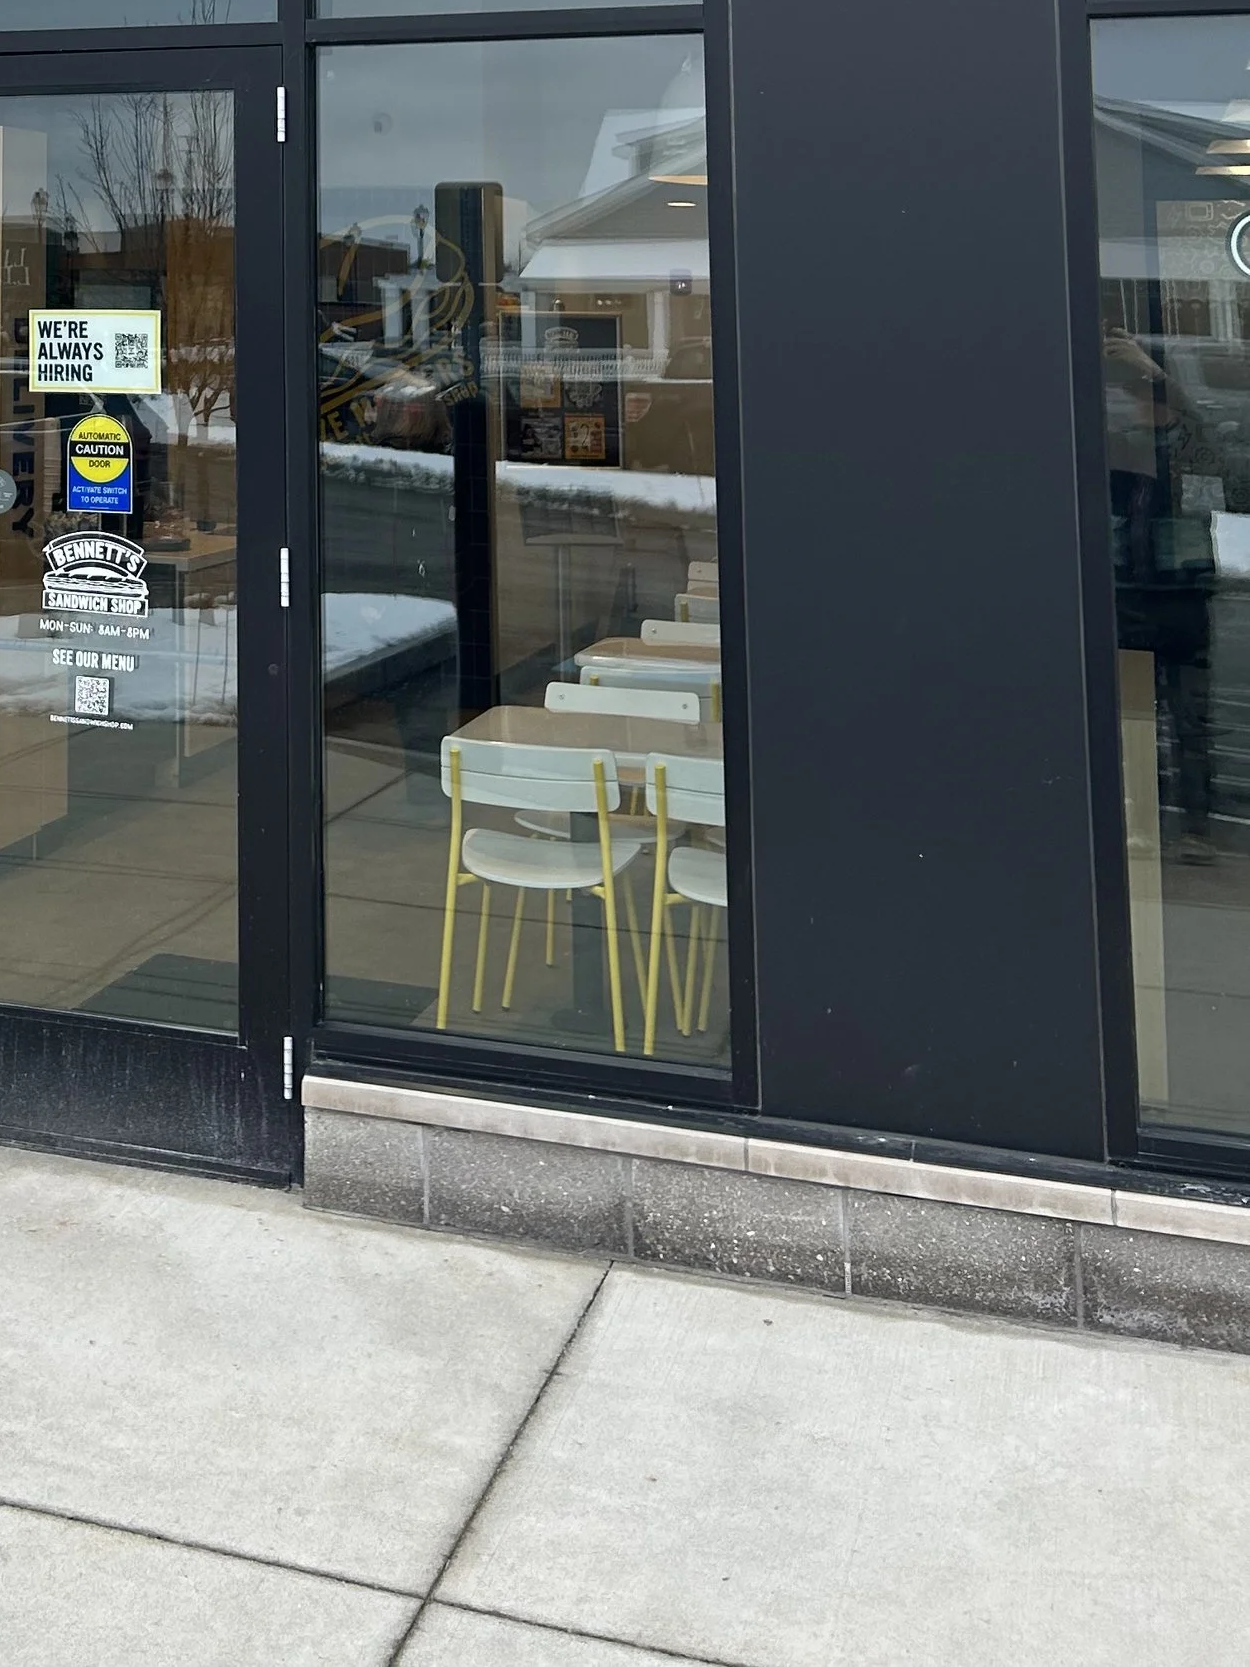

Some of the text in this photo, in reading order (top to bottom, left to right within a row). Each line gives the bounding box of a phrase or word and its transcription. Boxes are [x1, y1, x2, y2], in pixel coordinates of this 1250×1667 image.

[37, 320, 89, 339] WE'RE
[37, 342, 104, 361] ALWAYS
[37, 364, 94, 383] HIRING
[78, 431, 122, 441] AUTOMATIC
[75, 443, 125, 456] CAUTION
[89, 459, 111, 469] DOOR
[72, 485, 128, 495] ACTIVATE SWITCH
[81, 496, 119, 505] TO OPERATE
[52, 539, 142, 575] BENNETT'S
[47, 591, 143, 615] SANDWICH SHOP
[98, 623, 150, 640] 8AM-8PM
[52, 649, 136, 672] SEE OUR MENU
